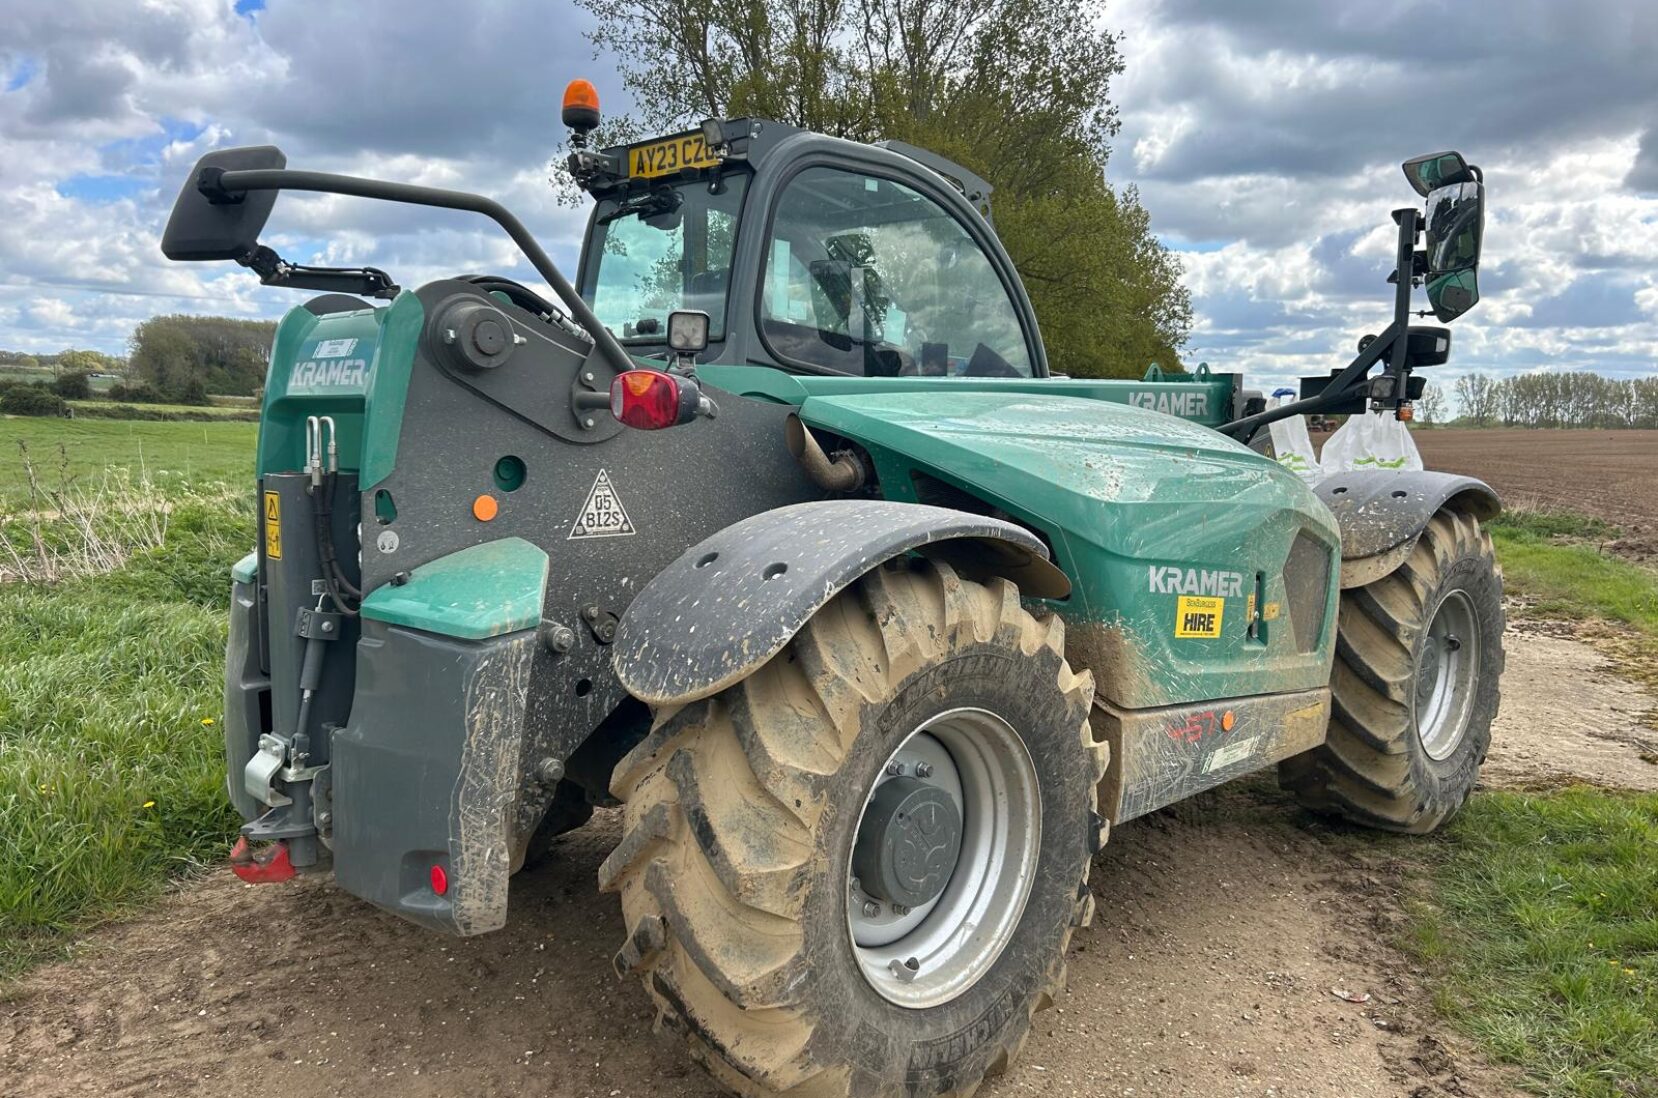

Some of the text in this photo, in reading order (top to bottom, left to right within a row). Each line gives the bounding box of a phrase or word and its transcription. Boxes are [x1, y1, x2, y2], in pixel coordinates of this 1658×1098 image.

[636, 143, 677, 175] AY23
[290, 359, 365, 386] KRAMER
[1128, 392, 1208, 416] KRAMER
[1149, 565, 1243, 598] KRAMER
[1183, 612, 1215, 632] HIRE
